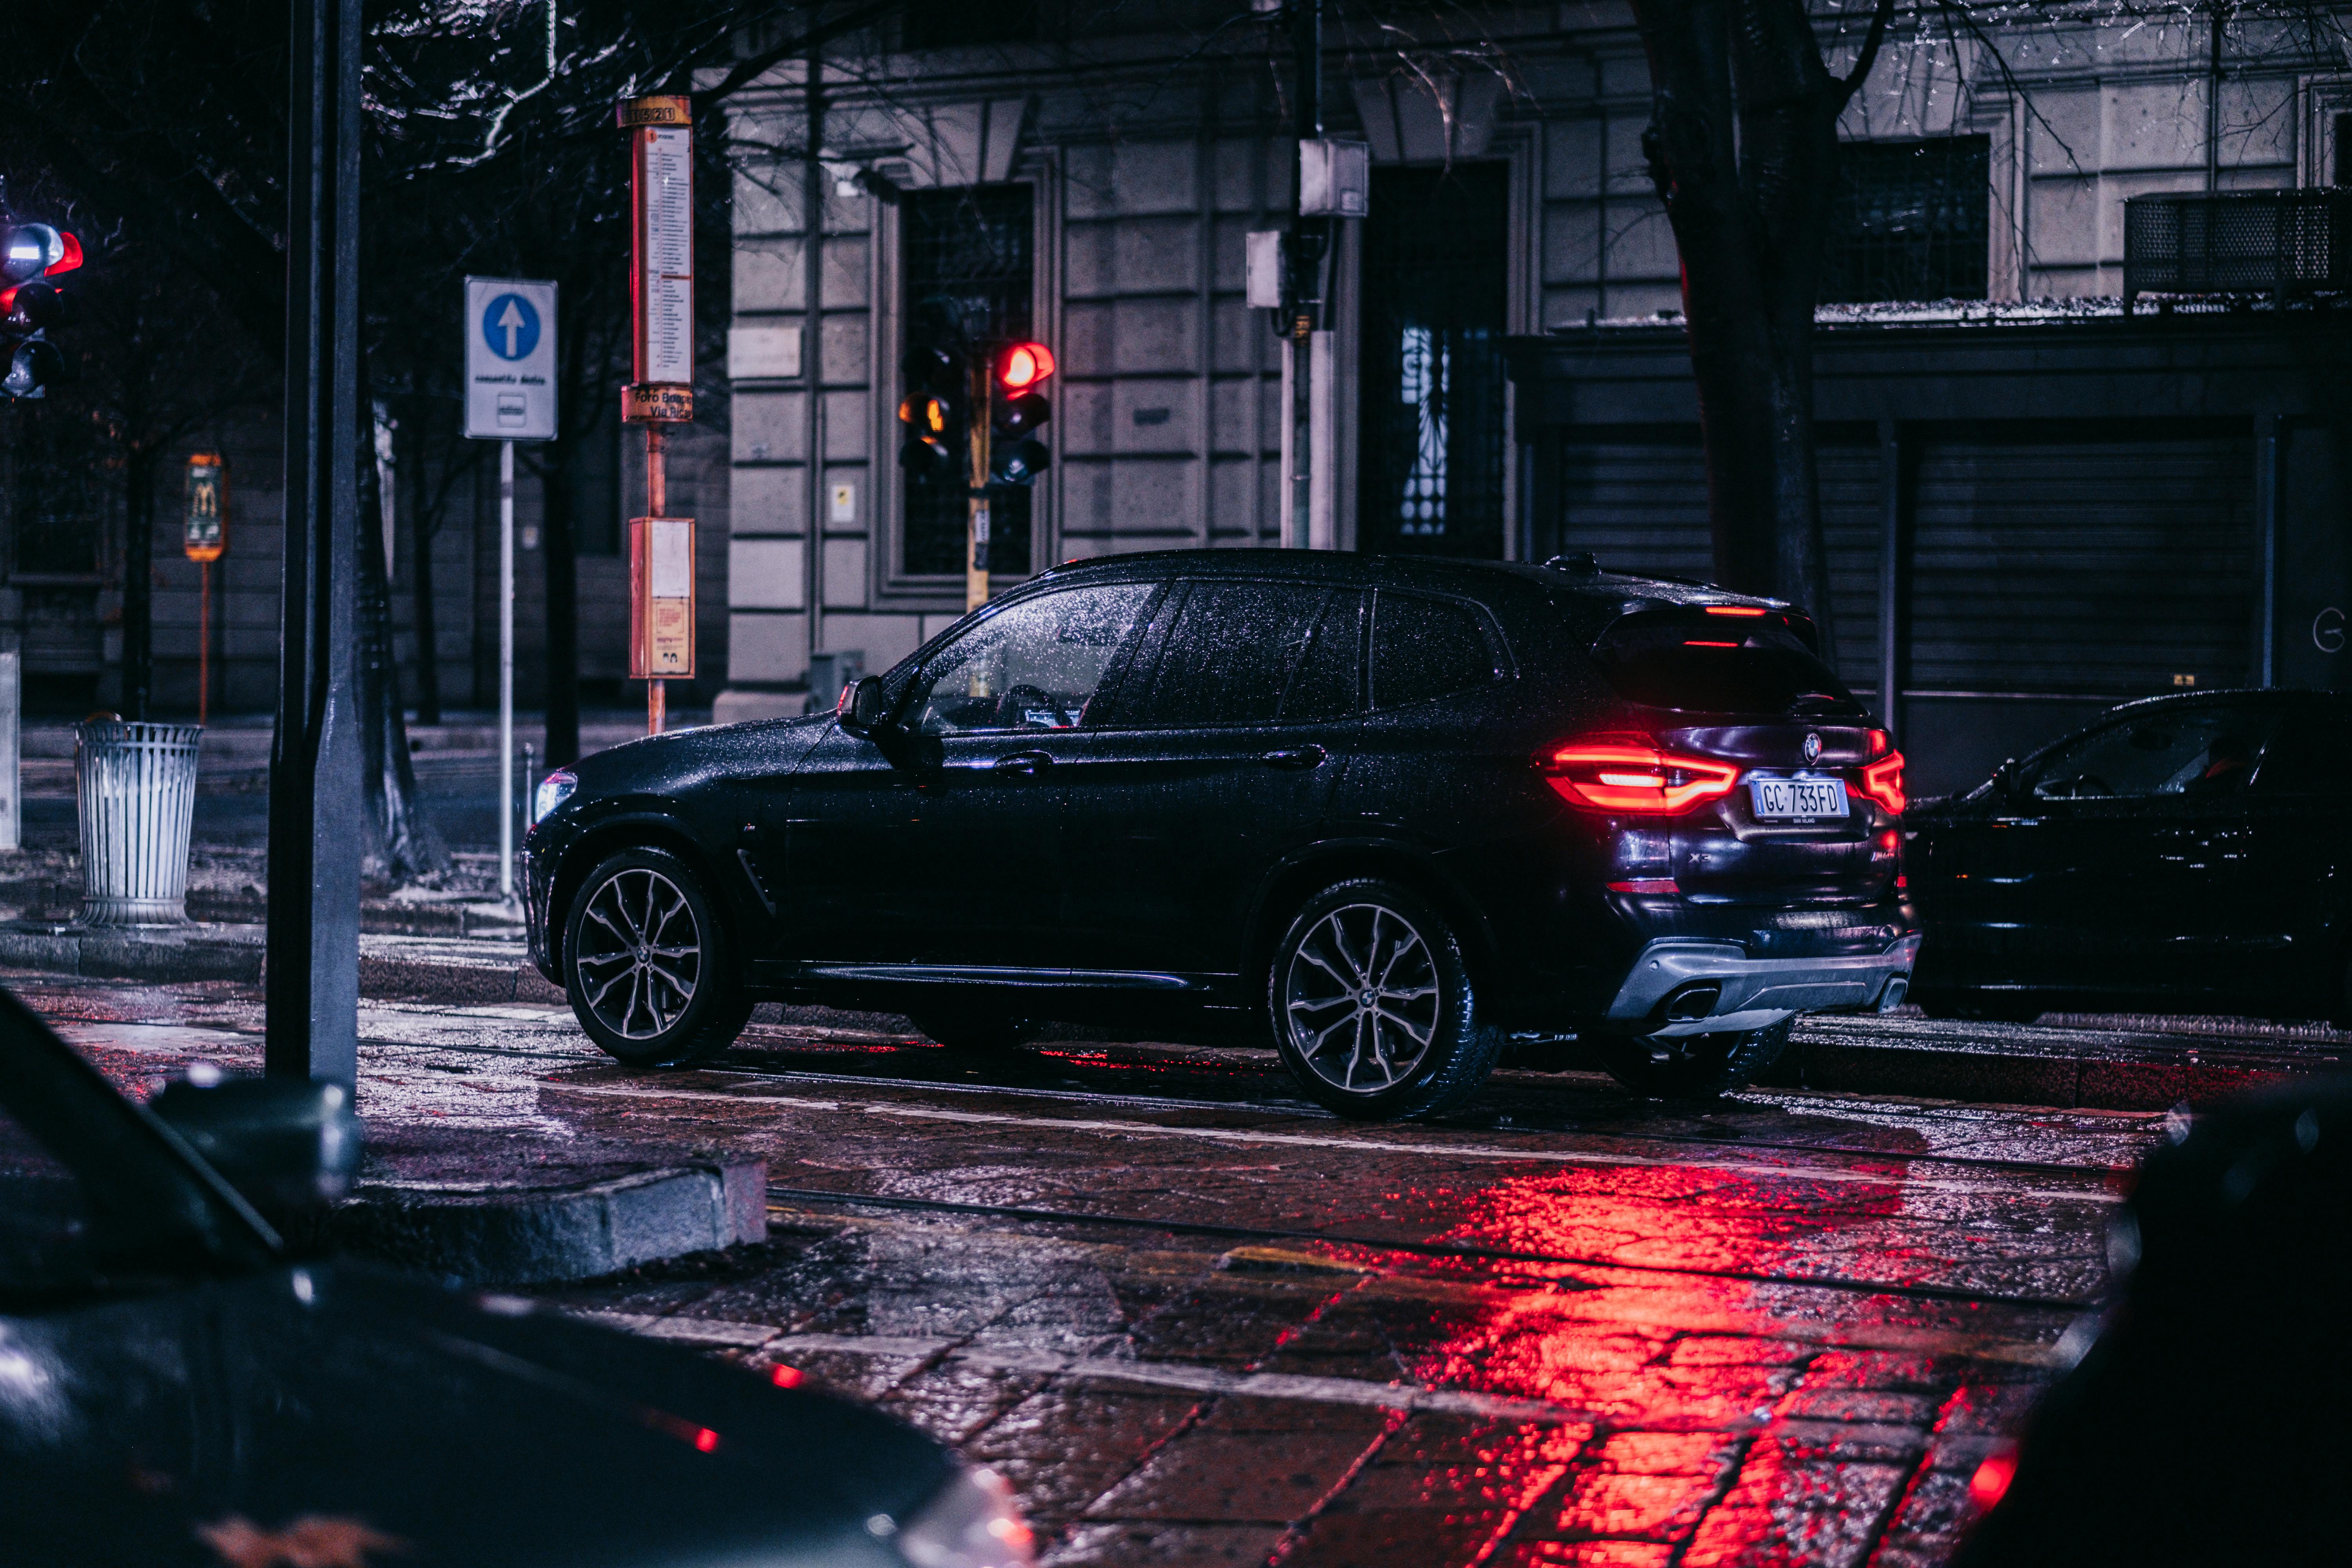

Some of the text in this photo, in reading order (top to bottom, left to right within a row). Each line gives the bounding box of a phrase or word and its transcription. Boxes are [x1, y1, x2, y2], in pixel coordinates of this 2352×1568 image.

[636, 392, 659, 403] Foro
[650, 406, 667, 417] Via
[1764, 784, 1837, 812] GC 733FD
[1688, 853, 1711, 863] X3
